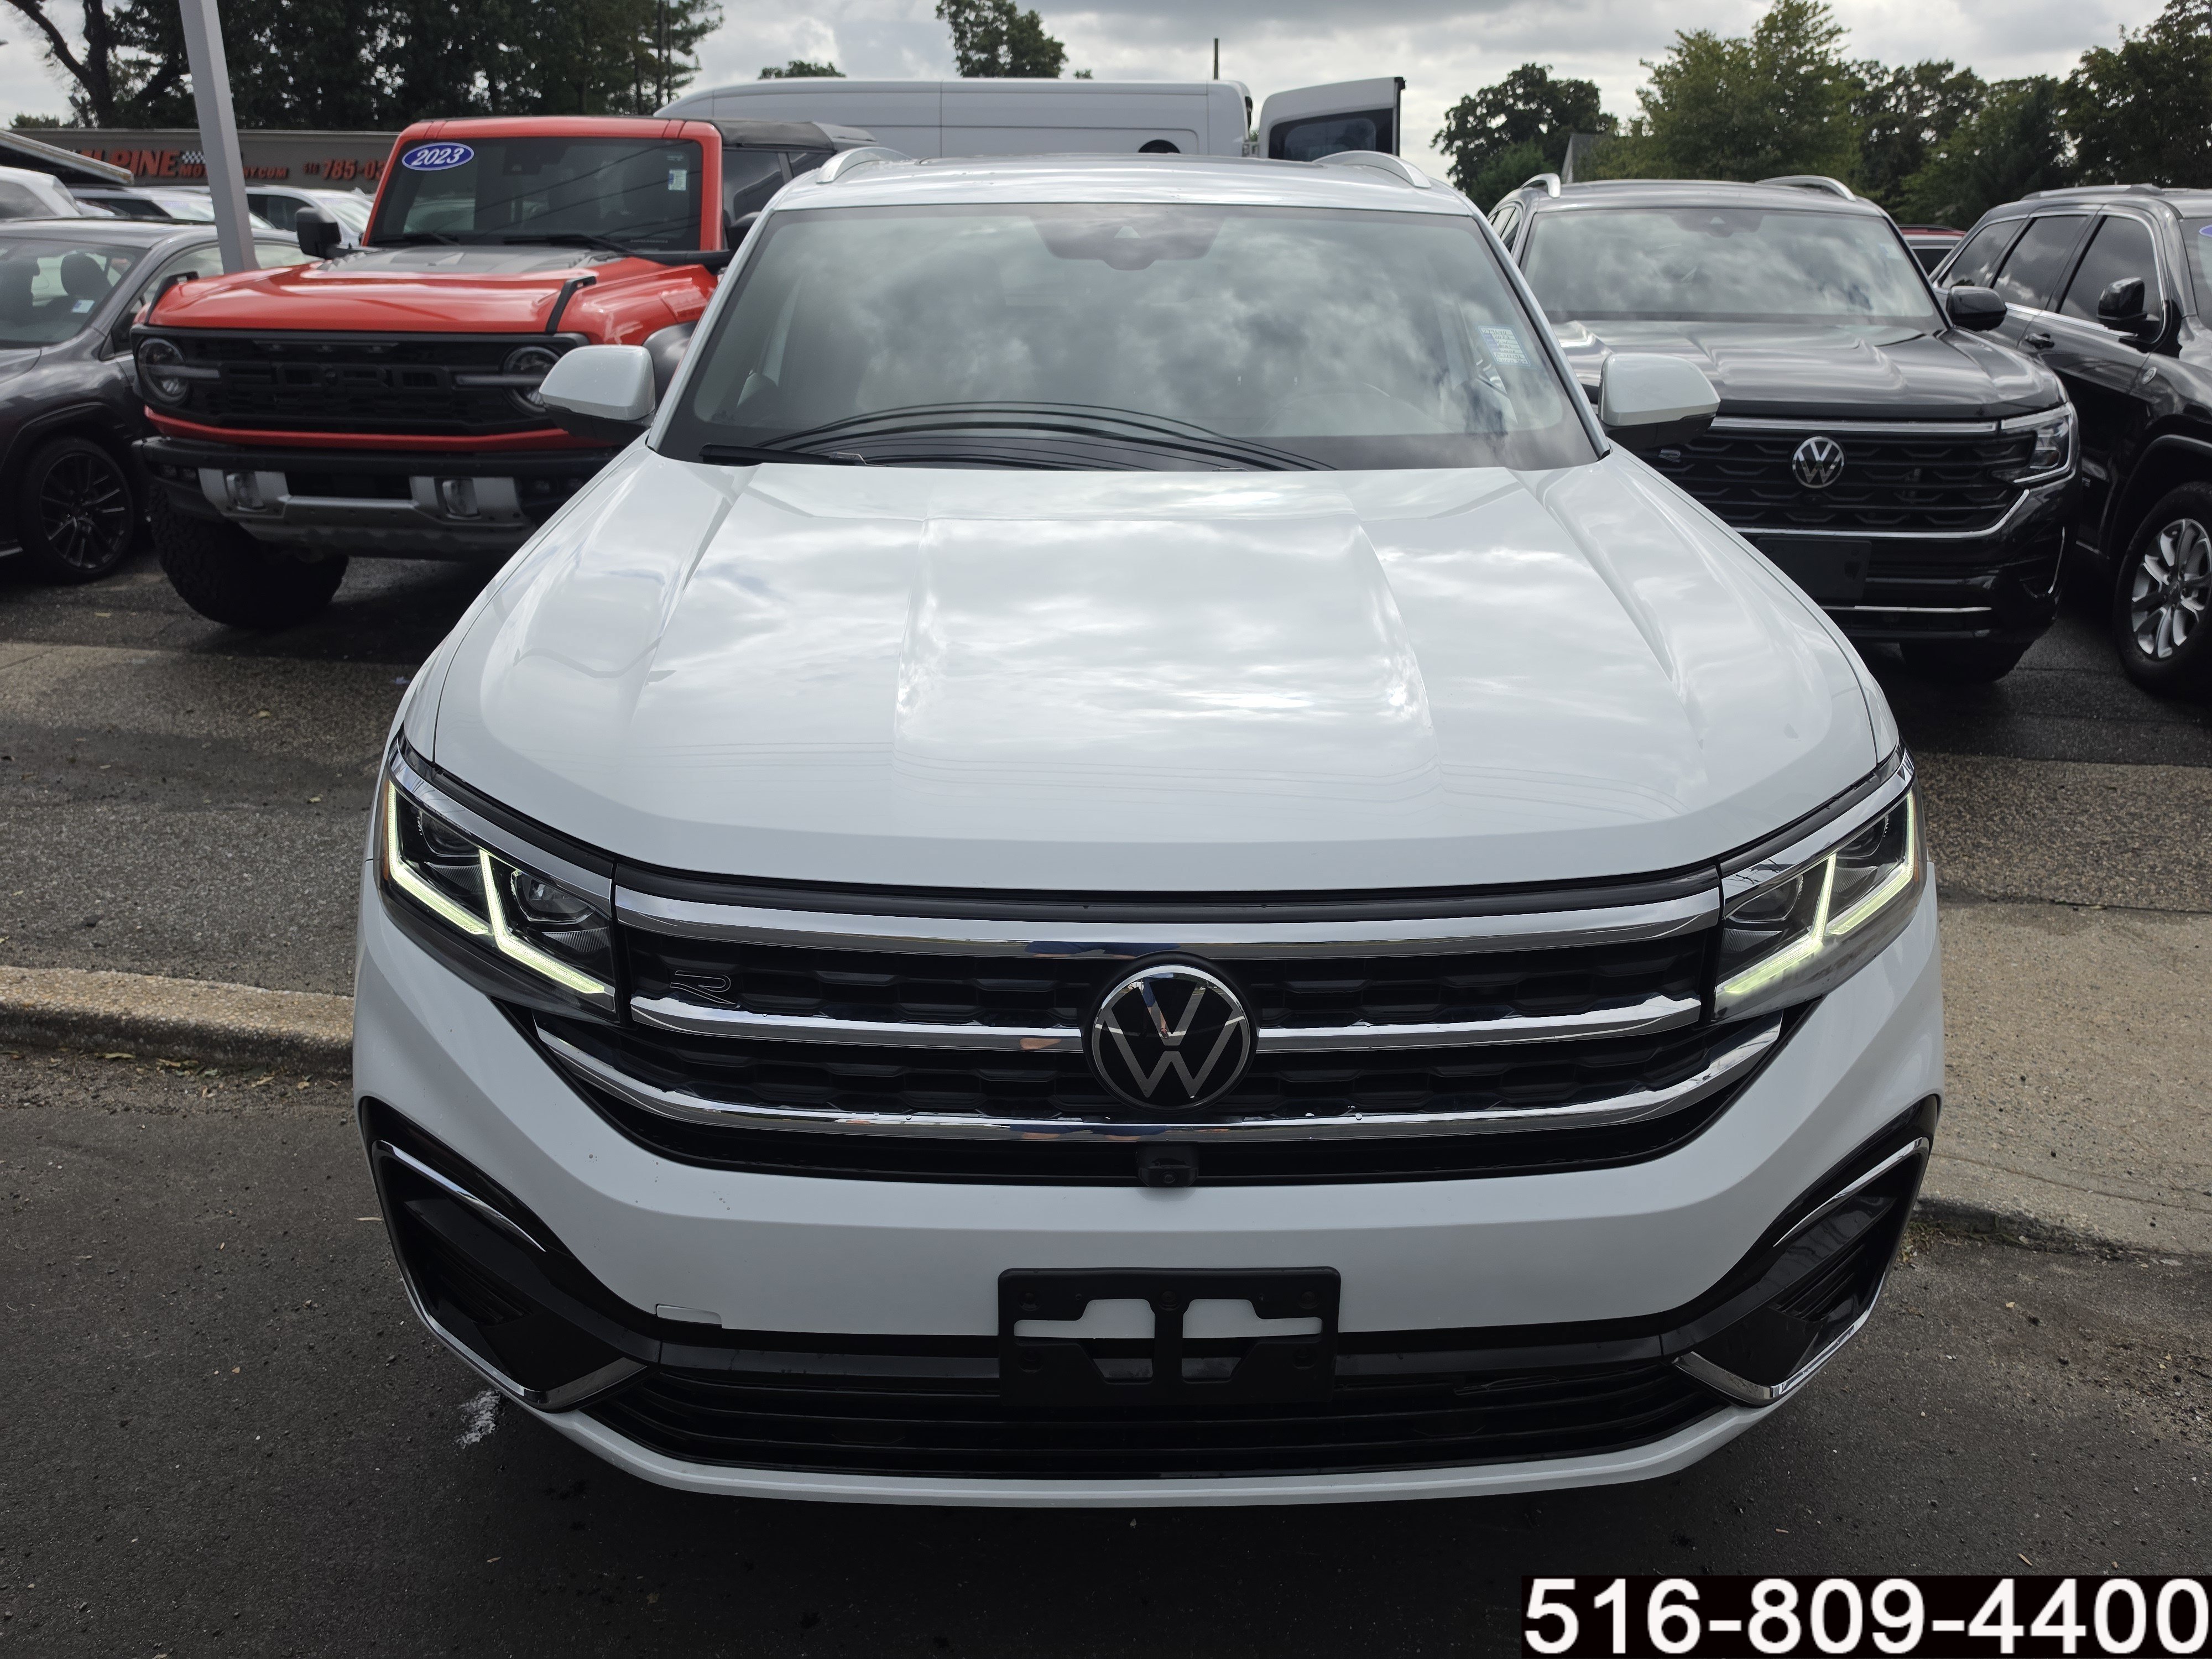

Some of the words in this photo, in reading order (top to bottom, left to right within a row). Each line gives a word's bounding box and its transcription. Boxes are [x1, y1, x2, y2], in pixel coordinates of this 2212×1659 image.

[411, 147, 465, 166] 2023
[221, 362, 451, 389] FORD
[1792, 436, 1844, 488] VW
[670, 970, 735, 1004] R
[1093, 967, 1249, 1106] VW
